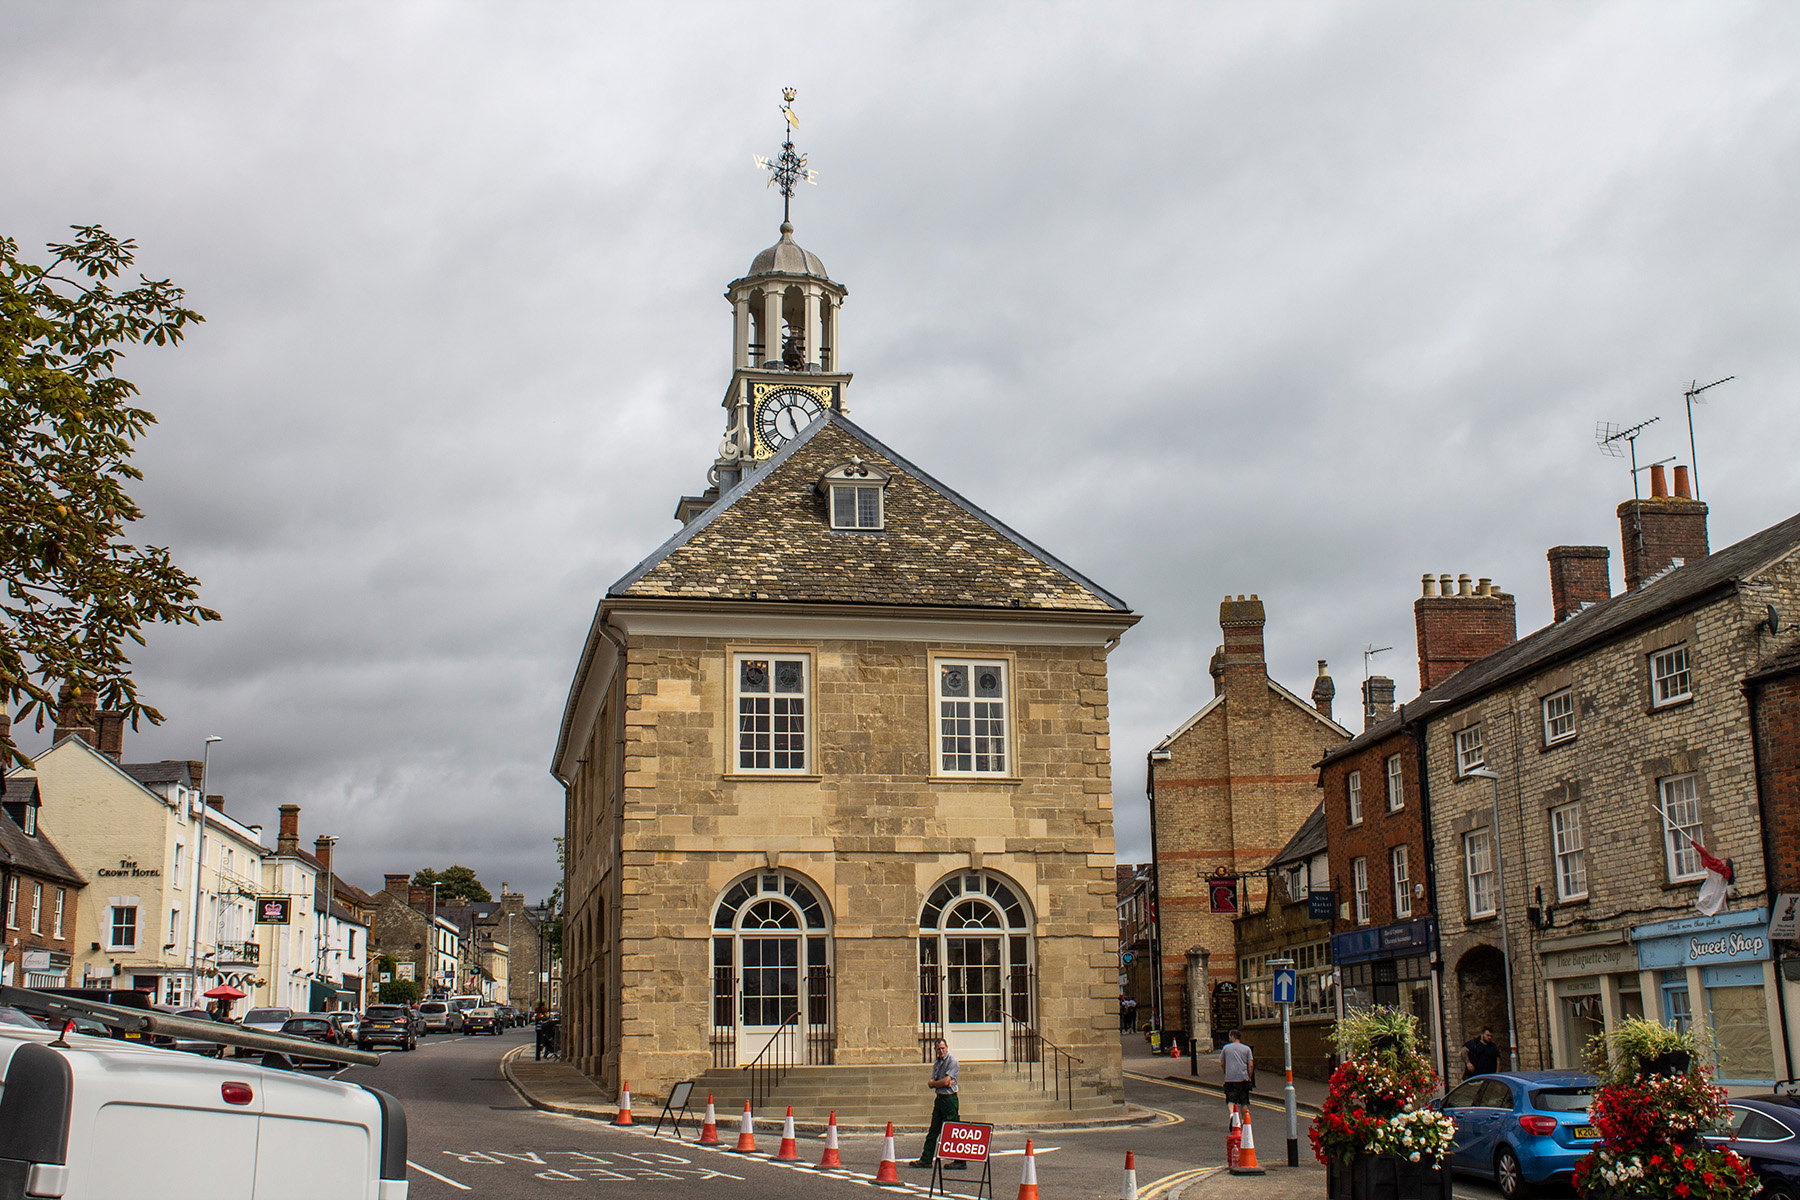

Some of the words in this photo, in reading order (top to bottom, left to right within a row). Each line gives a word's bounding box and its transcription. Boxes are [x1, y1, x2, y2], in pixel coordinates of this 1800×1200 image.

[752, 153, 768, 170] W
[808, 168, 818, 186] E
[98, 868, 129, 876] CROWN
[132, 868, 160, 876] HOTEL
[1689, 936, 1727, 960] Sweet
[1728, 932, 1763, 956] Shop
[1572, 952, 1602, 969] Baguette
[1603, 950, 1621, 965] Shop
[951, 1128, 982, 1140] ROAD
[942, 1141, 986, 1155] CLOSED
[442, 1151, 692, 1164] CLEAR
[534, 1168, 746, 1180] KEEP
